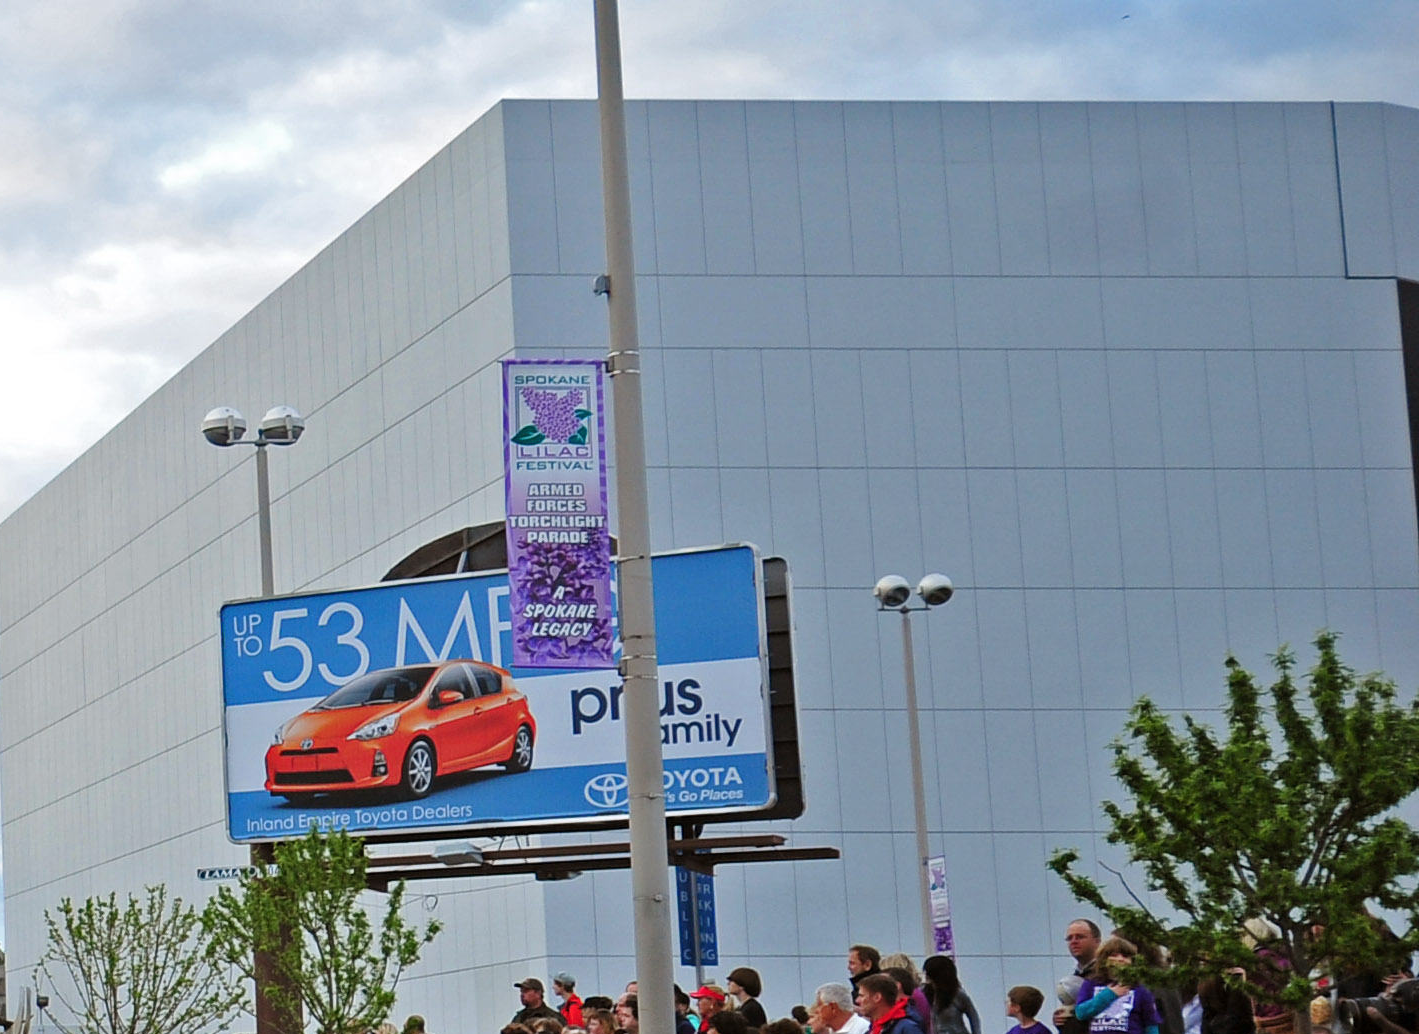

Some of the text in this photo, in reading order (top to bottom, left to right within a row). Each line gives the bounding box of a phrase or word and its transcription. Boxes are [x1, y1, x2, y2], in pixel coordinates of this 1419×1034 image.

[514, 375, 591, 385] SPOKANE
[520, 446, 589, 457] LILAC
[516, 461, 593, 470] FESTIVAL
[528, 483, 584, 496] ARMED
[526, 499, 587, 512] FORCES
[509, 515, 605, 528] TORCHLIGHT
[527, 531, 589, 544] PARADE
[553, 586, 565, 600] A
[523, 604, 597, 619] SPOKANE
[233, 614, 261, 636] UP
[532, 622, 593, 637] LEGACY
[233, 635, 262, 657] TO
[263, 602, 370, 692] 53
[571, 679, 703, 735] prus
[660, 713, 743, 747] amily
[663, 767, 743, 789] OYOTA
[678, 791, 698, 802] Go
[700, 789, 744, 800] Places
[247, 803, 473, 832] Inland Empire Toyota Dealers
